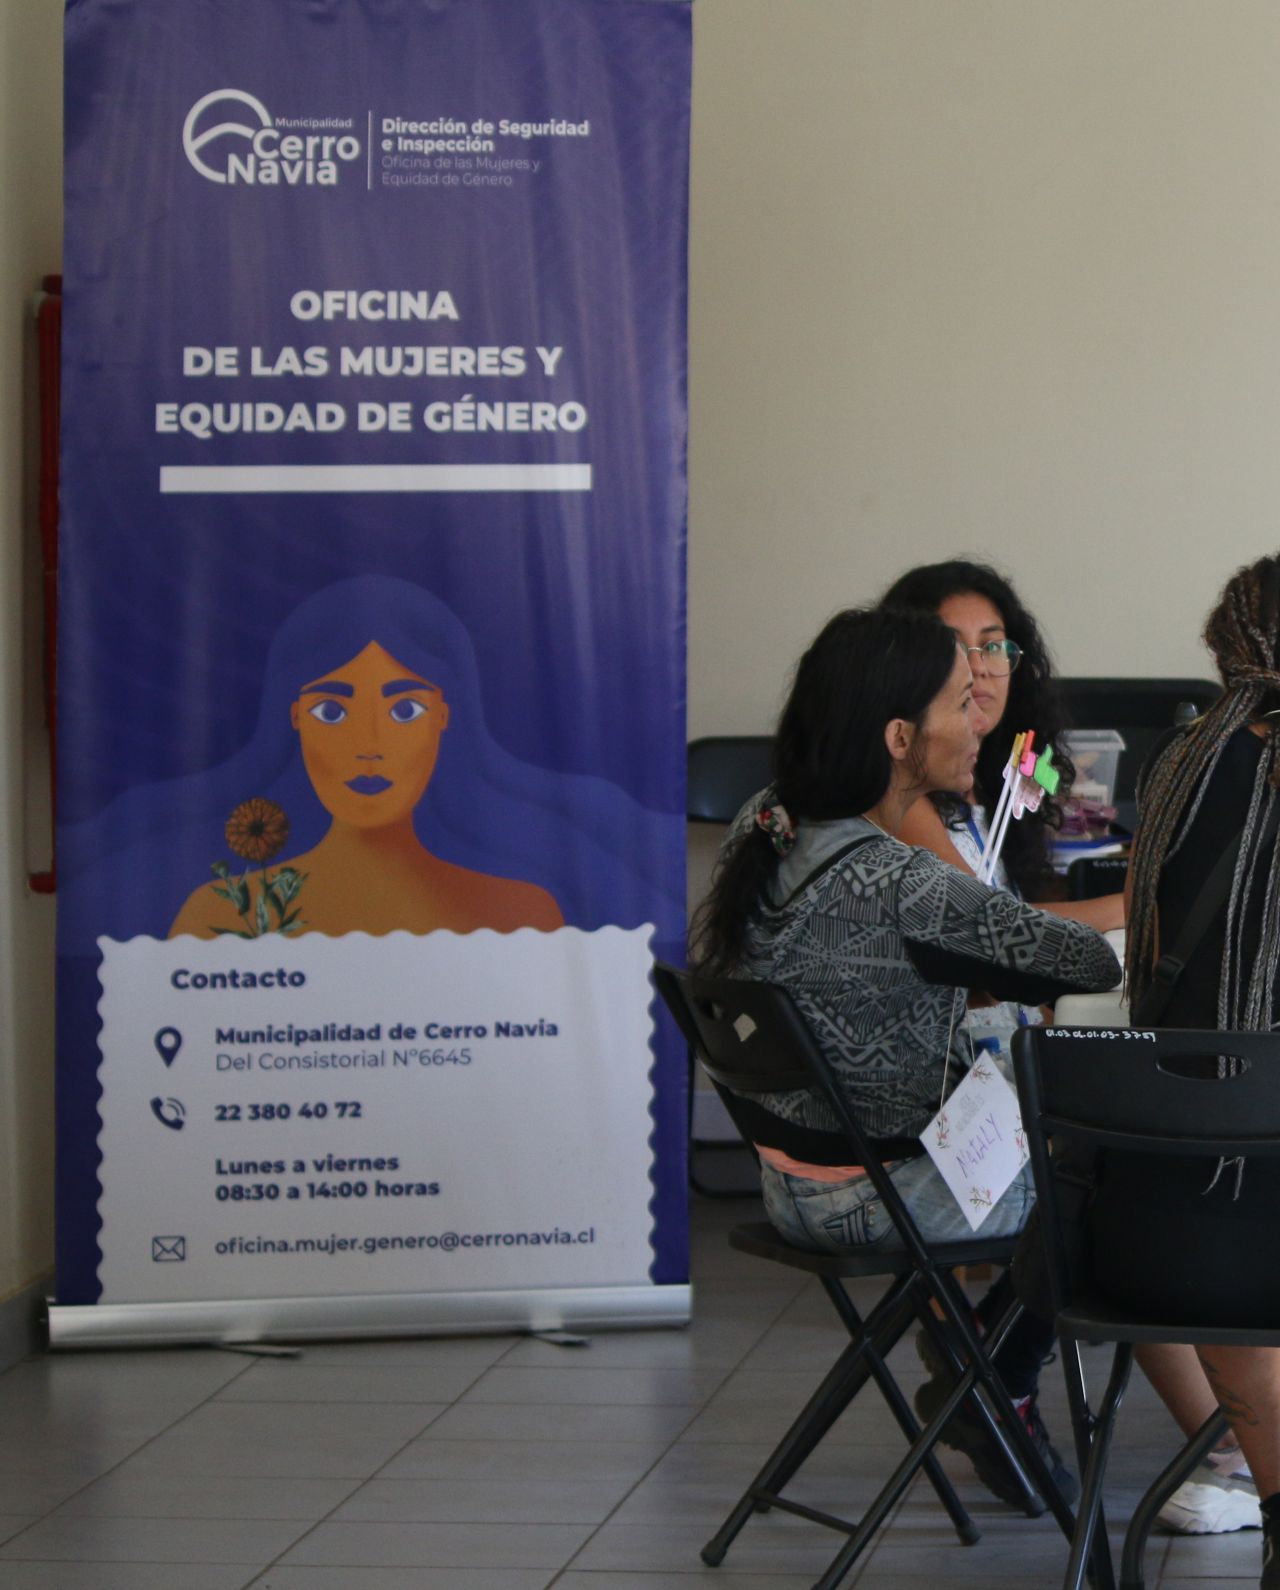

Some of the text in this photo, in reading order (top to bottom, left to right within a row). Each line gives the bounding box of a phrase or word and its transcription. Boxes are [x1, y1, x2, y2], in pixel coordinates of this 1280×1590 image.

[275, 117, 352, 130] Municipalidad
[382, 117, 590, 138] Dirección de Seguridad
[253, 128, 360, 160] Cerro
[381, 136, 495, 155] e Inspección
[227, 153, 338, 185] Navia
[381, 155, 431, 169] Oficina
[434, 156, 450, 169] de
[455, 157, 473, 169] las
[477, 157, 530, 173] Mujeres
[381, 172, 513, 188] Equidad de Género
[290, 291, 459, 320] OFICINA
[183, 347, 563, 376] DE LAS MUJERES Y
[155, 394, 588, 438] EQUIDAD DE GÉNERO
[171, 968, 306, 990] Contacto
[215, 1019, 559, 1045] Municipalidad de Cerro Navia
[216, 1053, 252, 1071] Del
[258, 1049, 385, 1070] Consistorial
[215, 1101, 362, 1121] 22 380 40 72
[215, 1154, 400, 1175] Lunes a viernes
[215, 1180, 441, 1201] 08:30 a 14:00 horas
[215, 1227, 595, 1255] oficina.mujer.genero@cerronavia.cl
